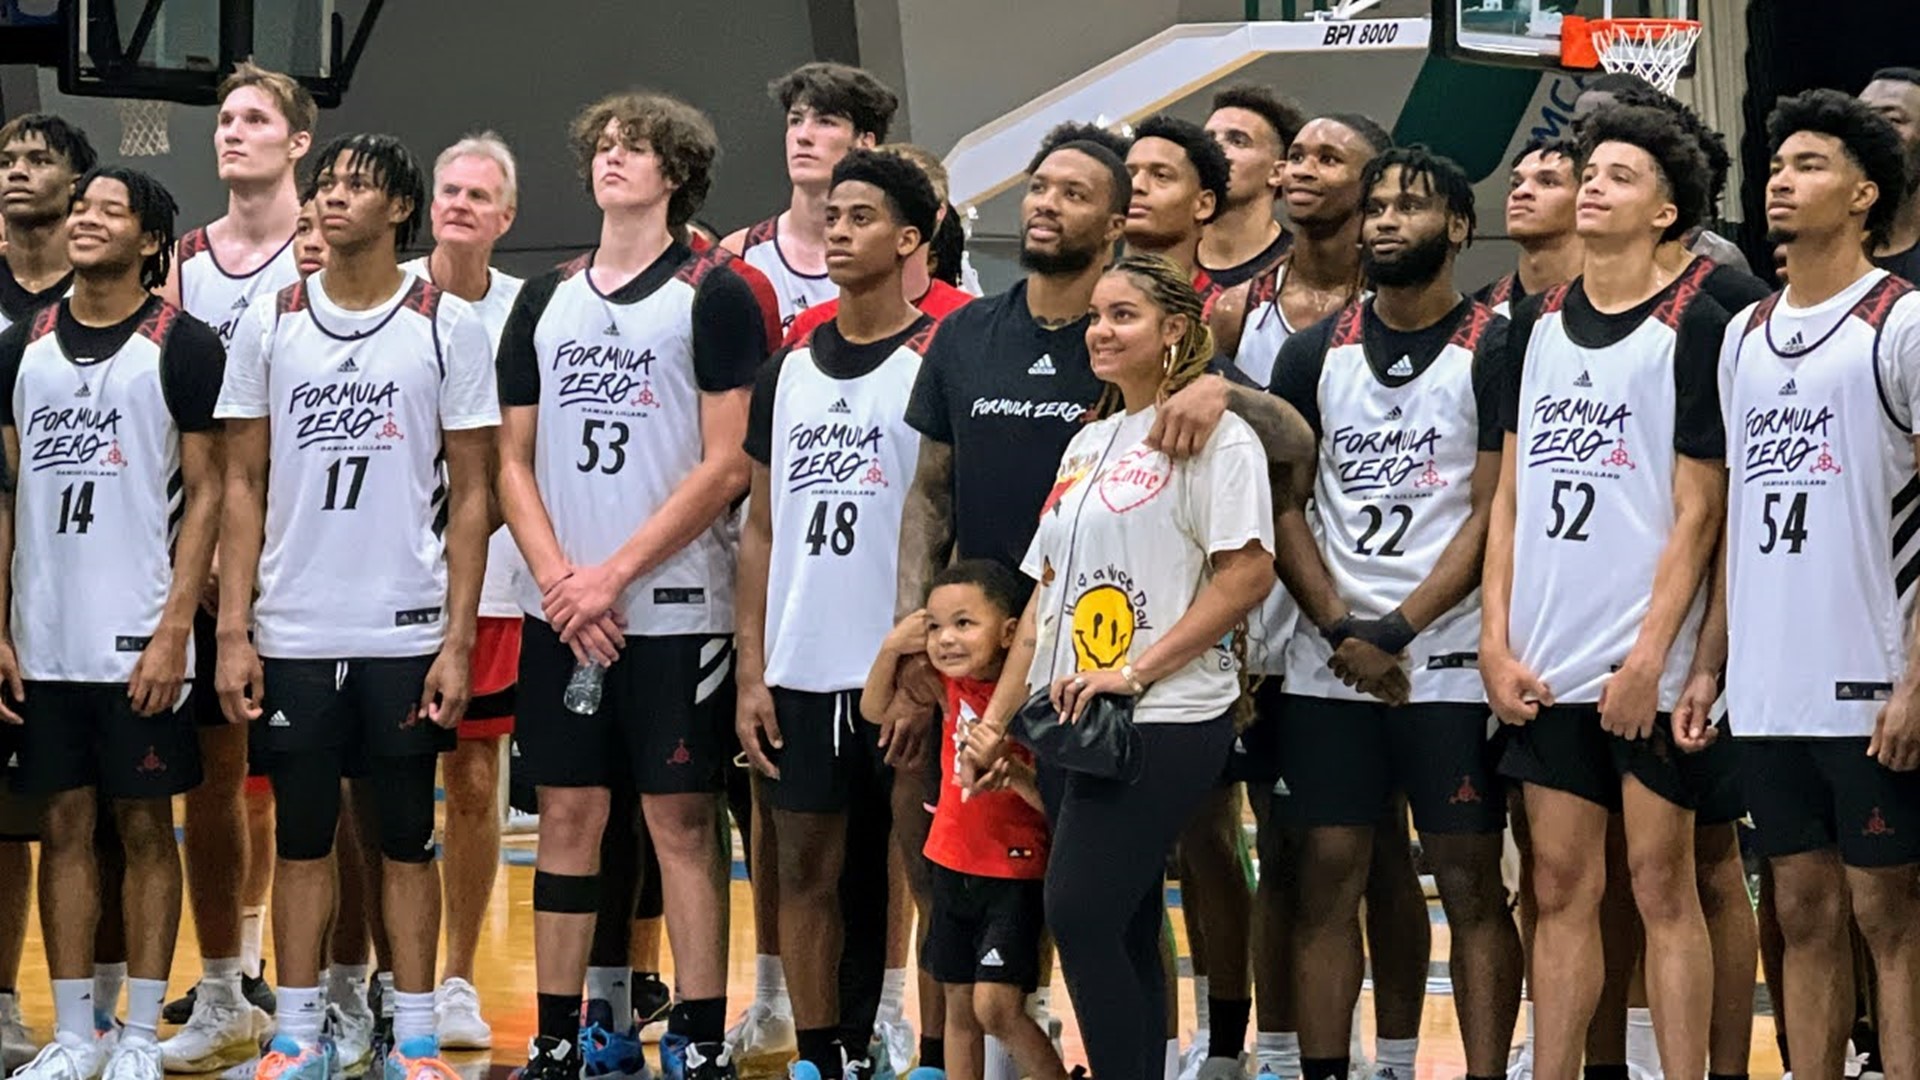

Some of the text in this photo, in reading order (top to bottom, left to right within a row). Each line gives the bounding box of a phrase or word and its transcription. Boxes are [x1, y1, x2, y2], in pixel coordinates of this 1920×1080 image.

[1322, 23, 1399, 45] BPI 8000
[552, 340, 656, 375] FORMULA
[289, 381, 399, 414] FORMULA
[971, 397, 1032, 418] FORMULA
[1530, 395, 1632, 433] FORMULA
[27, 405, 122, 435] FORMULA
[788, 423, 883, 453] FORMULA
[1744, 406, 1834, 444] FORMULA
[577, 419, 630, 475] 53
[1332, 426, 1442, 455] FORMULA
[321, 456, 370, 511] 17
[57, 481, 95, 533] 14
[1546, 479, 1596, 542] 52
[1759, 492, 1808, 554] 54
[805, 500, 858, 556] 48
[1353, 504, 1413, 557] 22
[1133, 590, 1153, 630] Day
